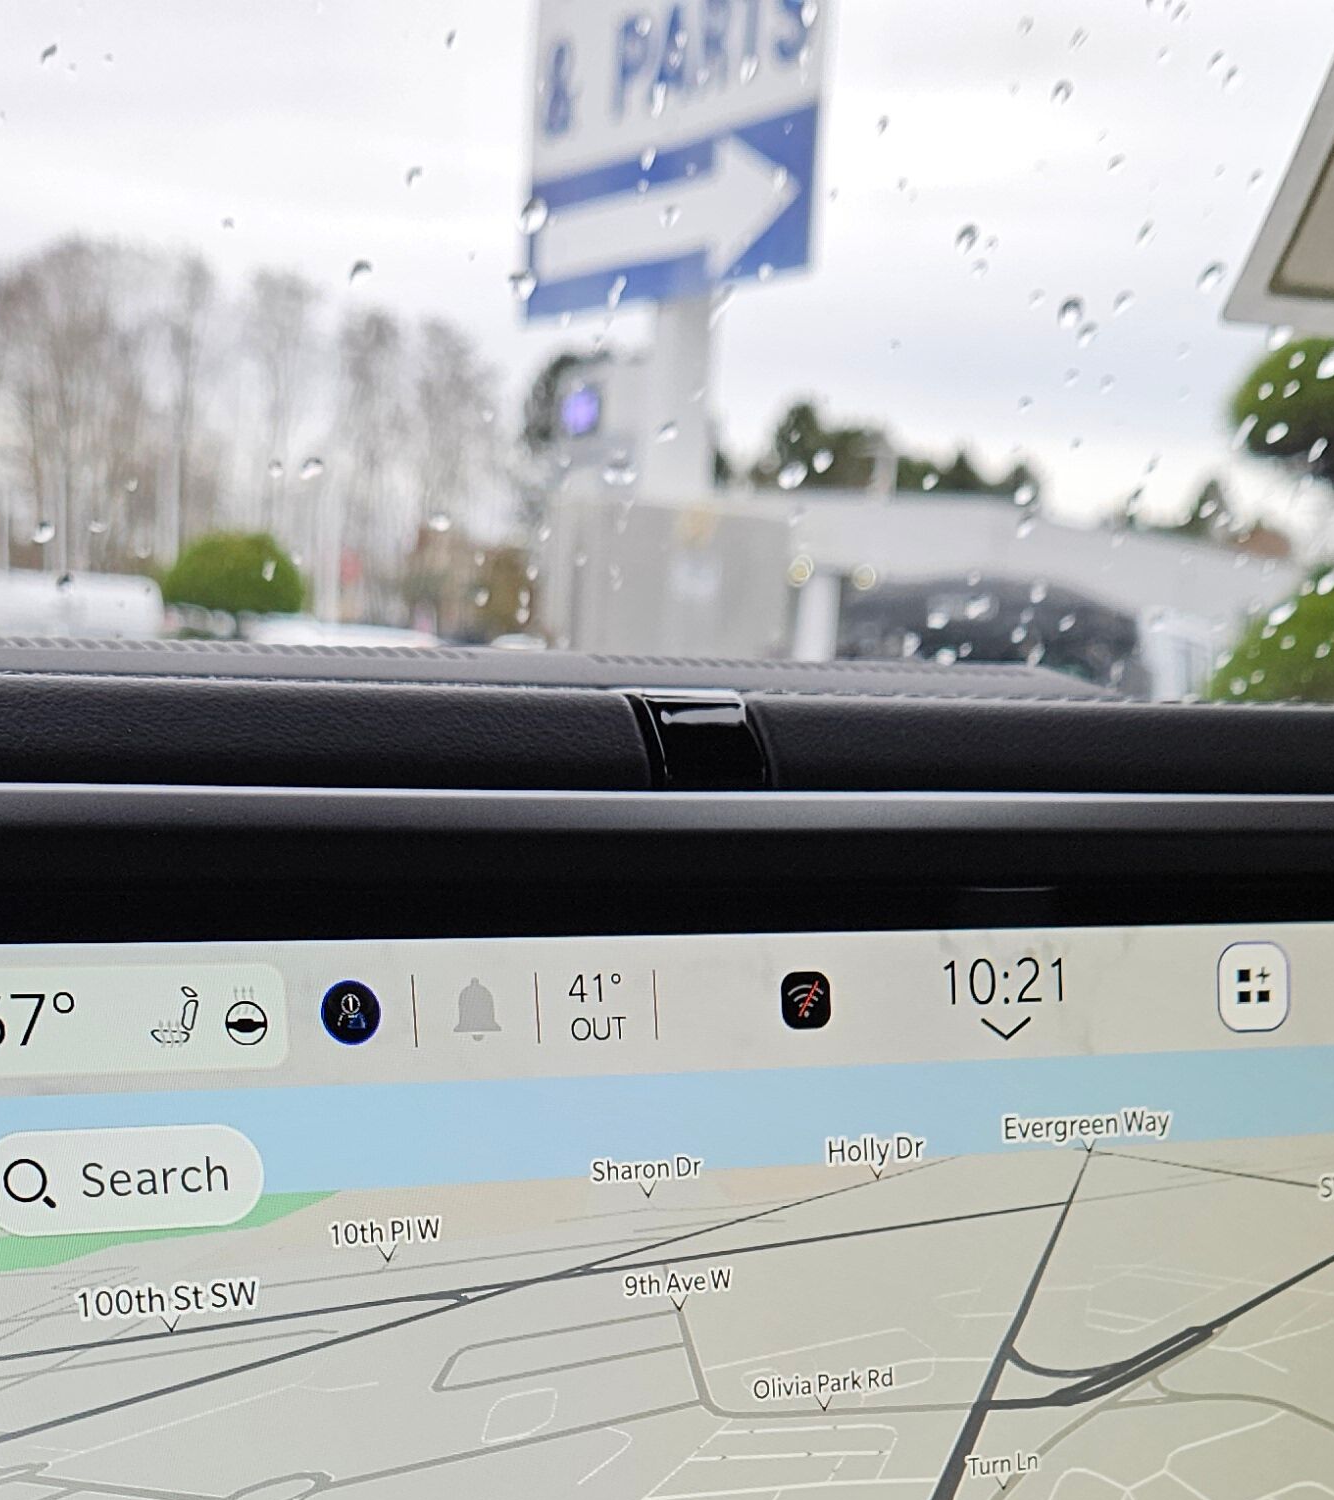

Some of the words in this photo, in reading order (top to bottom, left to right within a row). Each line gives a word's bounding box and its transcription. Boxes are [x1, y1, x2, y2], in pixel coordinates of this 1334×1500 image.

[569, 971, 622, 1004] 41°
[943, 956, 1067, 1006] 10:21
[570, 1016, 628, 1042] OUT
[1003, 1113, 1119, 1142] Evergreen
[1123, 1111, 1170, 1138] Way
[827, 1139, 892, 1167] Holly
[896, 1136, 925, 1160] Dr
[80, 1156, 230, 1201] Search
[591, 1160, 670, 1184] Sharon
[674, 1156, 703, 1178] Dr
[330, 1221, 384, 1246] 10th
[412, 1217, 441, 1240] W
[77, 1287, 165, 1318] 100th
[172, 1284, 206, 1311] St
[210, 1280, 259, 1308] SW
[623, 1274, 662, 1298] 9th
[666, 1271, 706, 1294] Ave
[708, 1269, 732, 1291] W
[753, 1376, 813, 1401] Olivia
[817, 1372, 862, 1395] Park
[865, 1367, 894, 1389] Rd
[967, 1454, 1012, 1477] Turn
[1016, 1451, 1039, 1472] Ln
